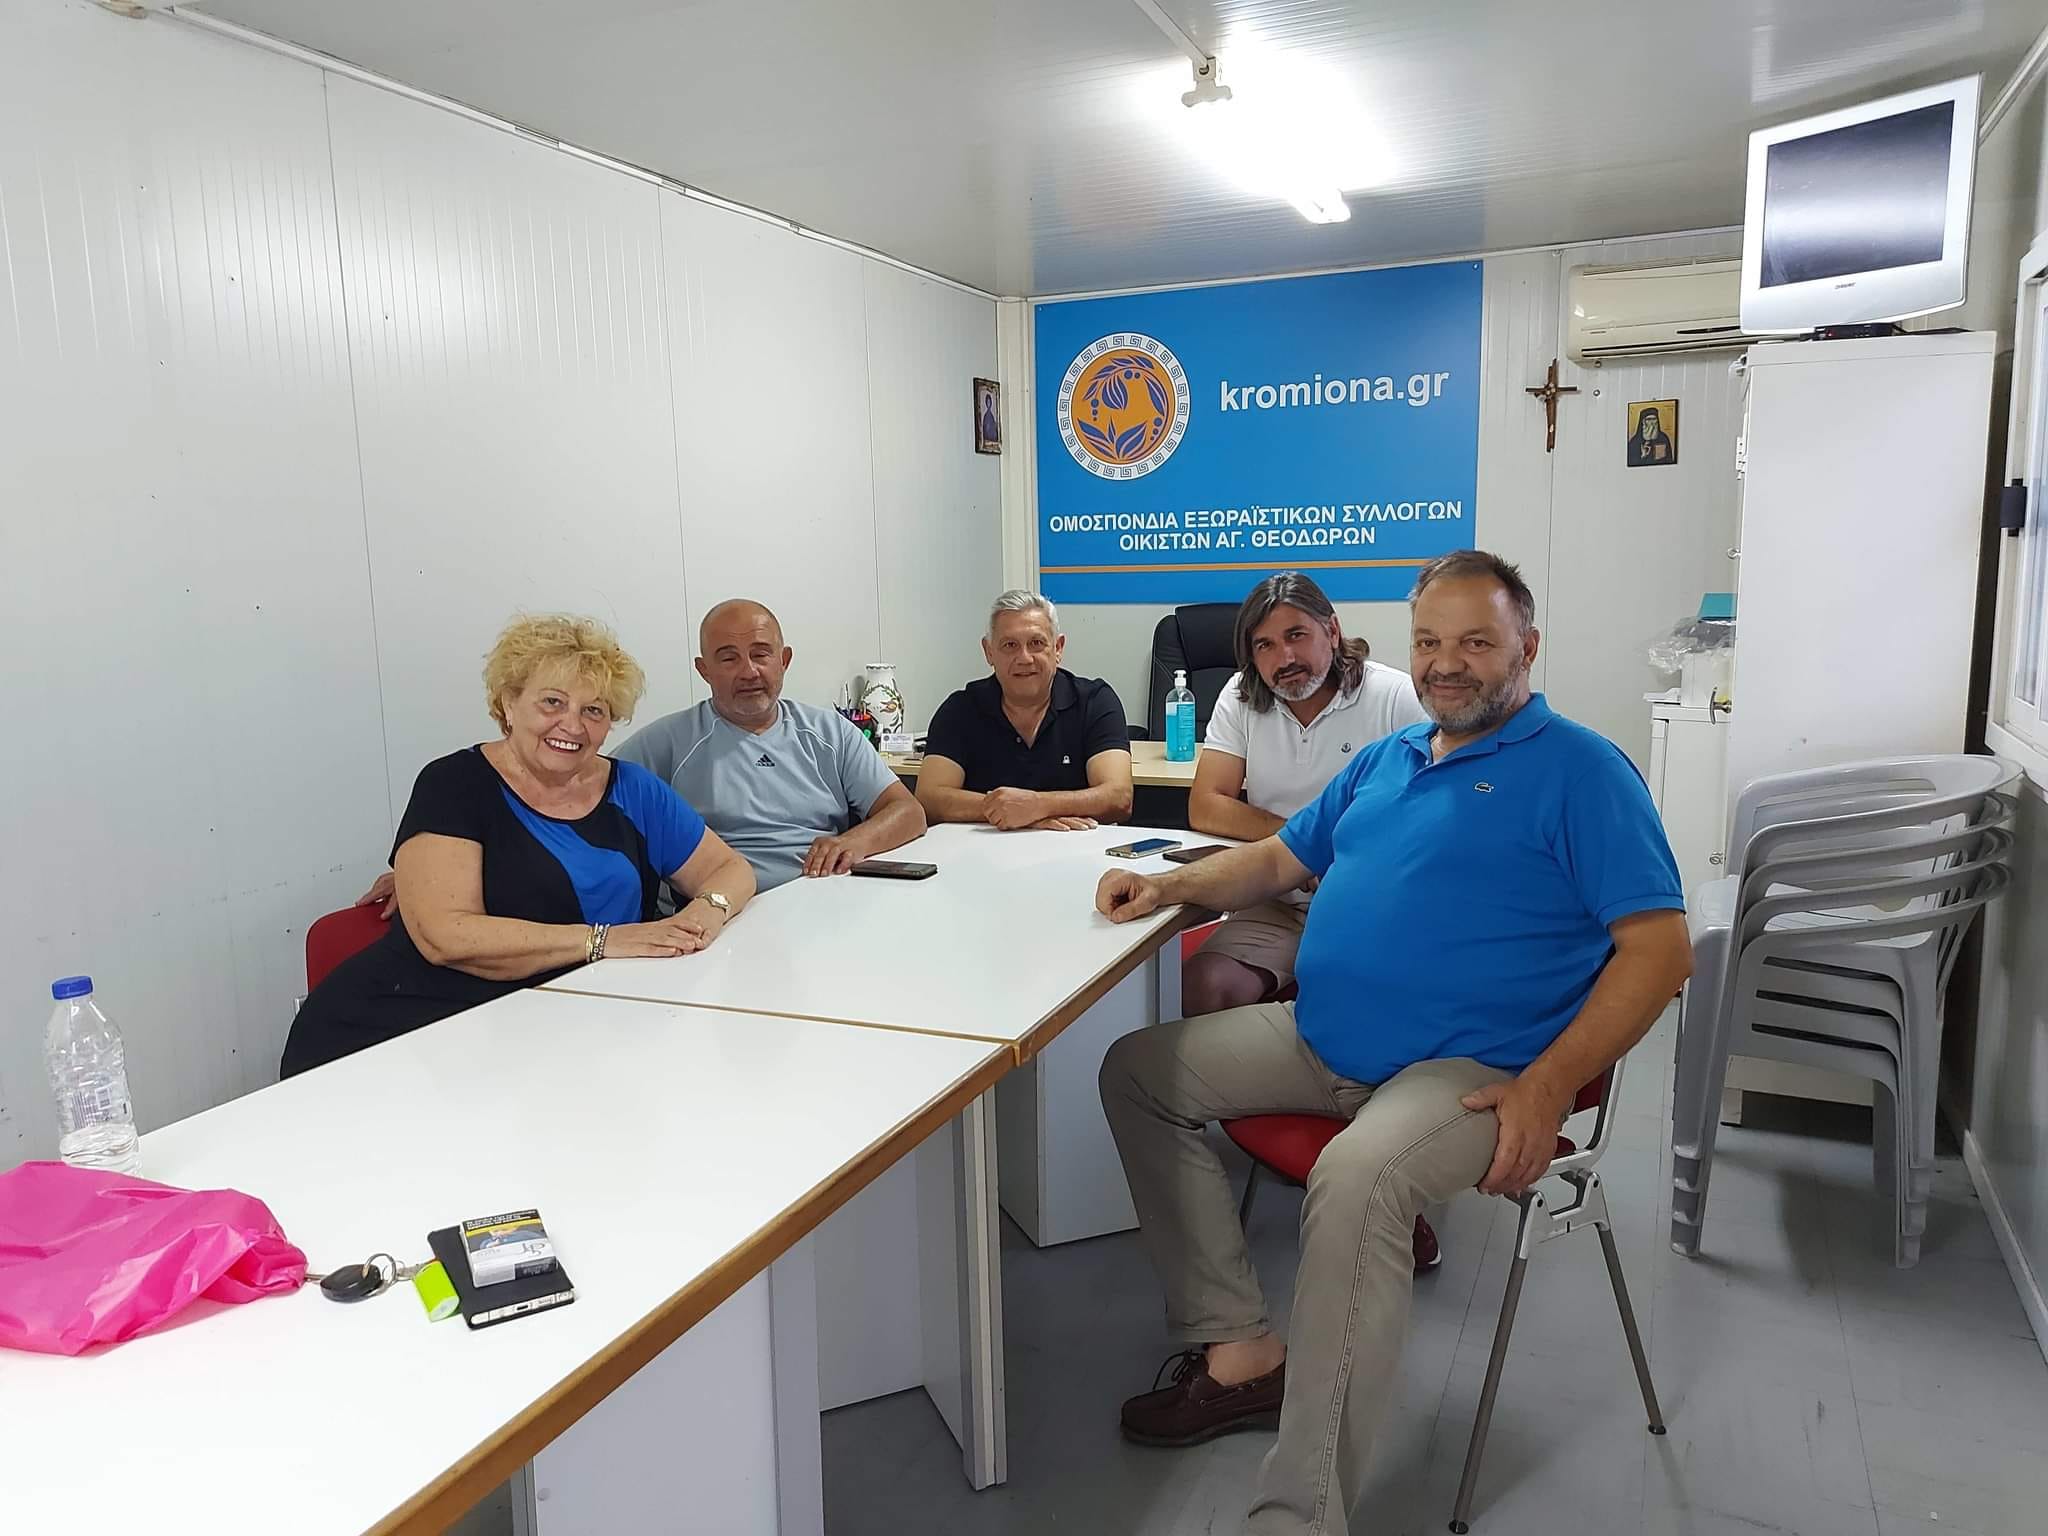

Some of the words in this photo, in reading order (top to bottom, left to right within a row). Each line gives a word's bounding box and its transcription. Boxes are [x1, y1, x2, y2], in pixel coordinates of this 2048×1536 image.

[1220, 372, 1450, 412] kromiona.gr
[1050, 512, 1179, 532] ΟΜΟΣΠΟΝΔΙΑ
[1184, 505, 1335, 527] ΕΞΩΡΑΪΣΤΙΚΩΝ
[1342, 501, 1462, 523] ΣΥΛΛΟΓΩΝ
[1119, 531, 1210, 551] ΟΙΚΙΣΤΩΝ
[1215, 530, 1246, 548] ΑΓ.
[1251, 526, 1376, 547] ΘΕΟΔΩΡΩΝ
